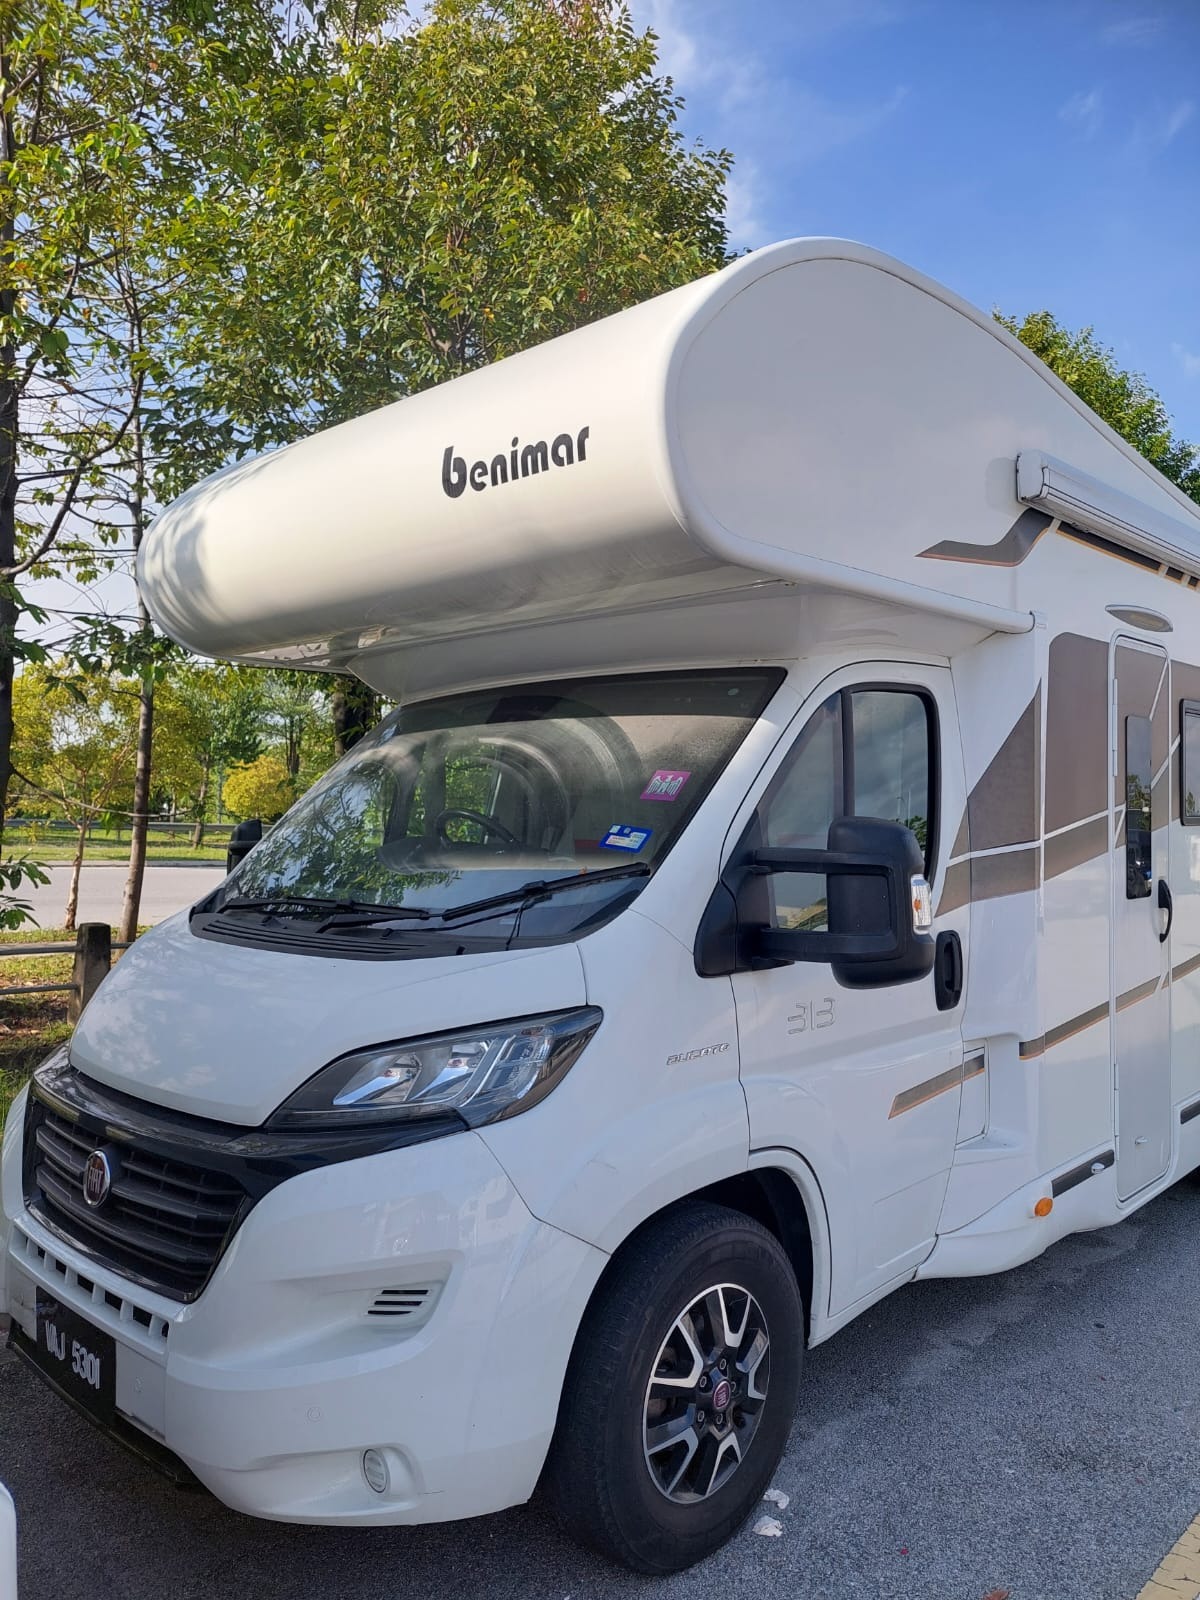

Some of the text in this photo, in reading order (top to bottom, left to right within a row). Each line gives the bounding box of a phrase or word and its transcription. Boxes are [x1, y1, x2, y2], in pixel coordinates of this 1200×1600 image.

[442, 426, 590, 499] benimar
[787, 997, 836, 1035] 313
[87, 1165, 104, 1195] FIAT
[71, 1340, 101, 1390] 5301
